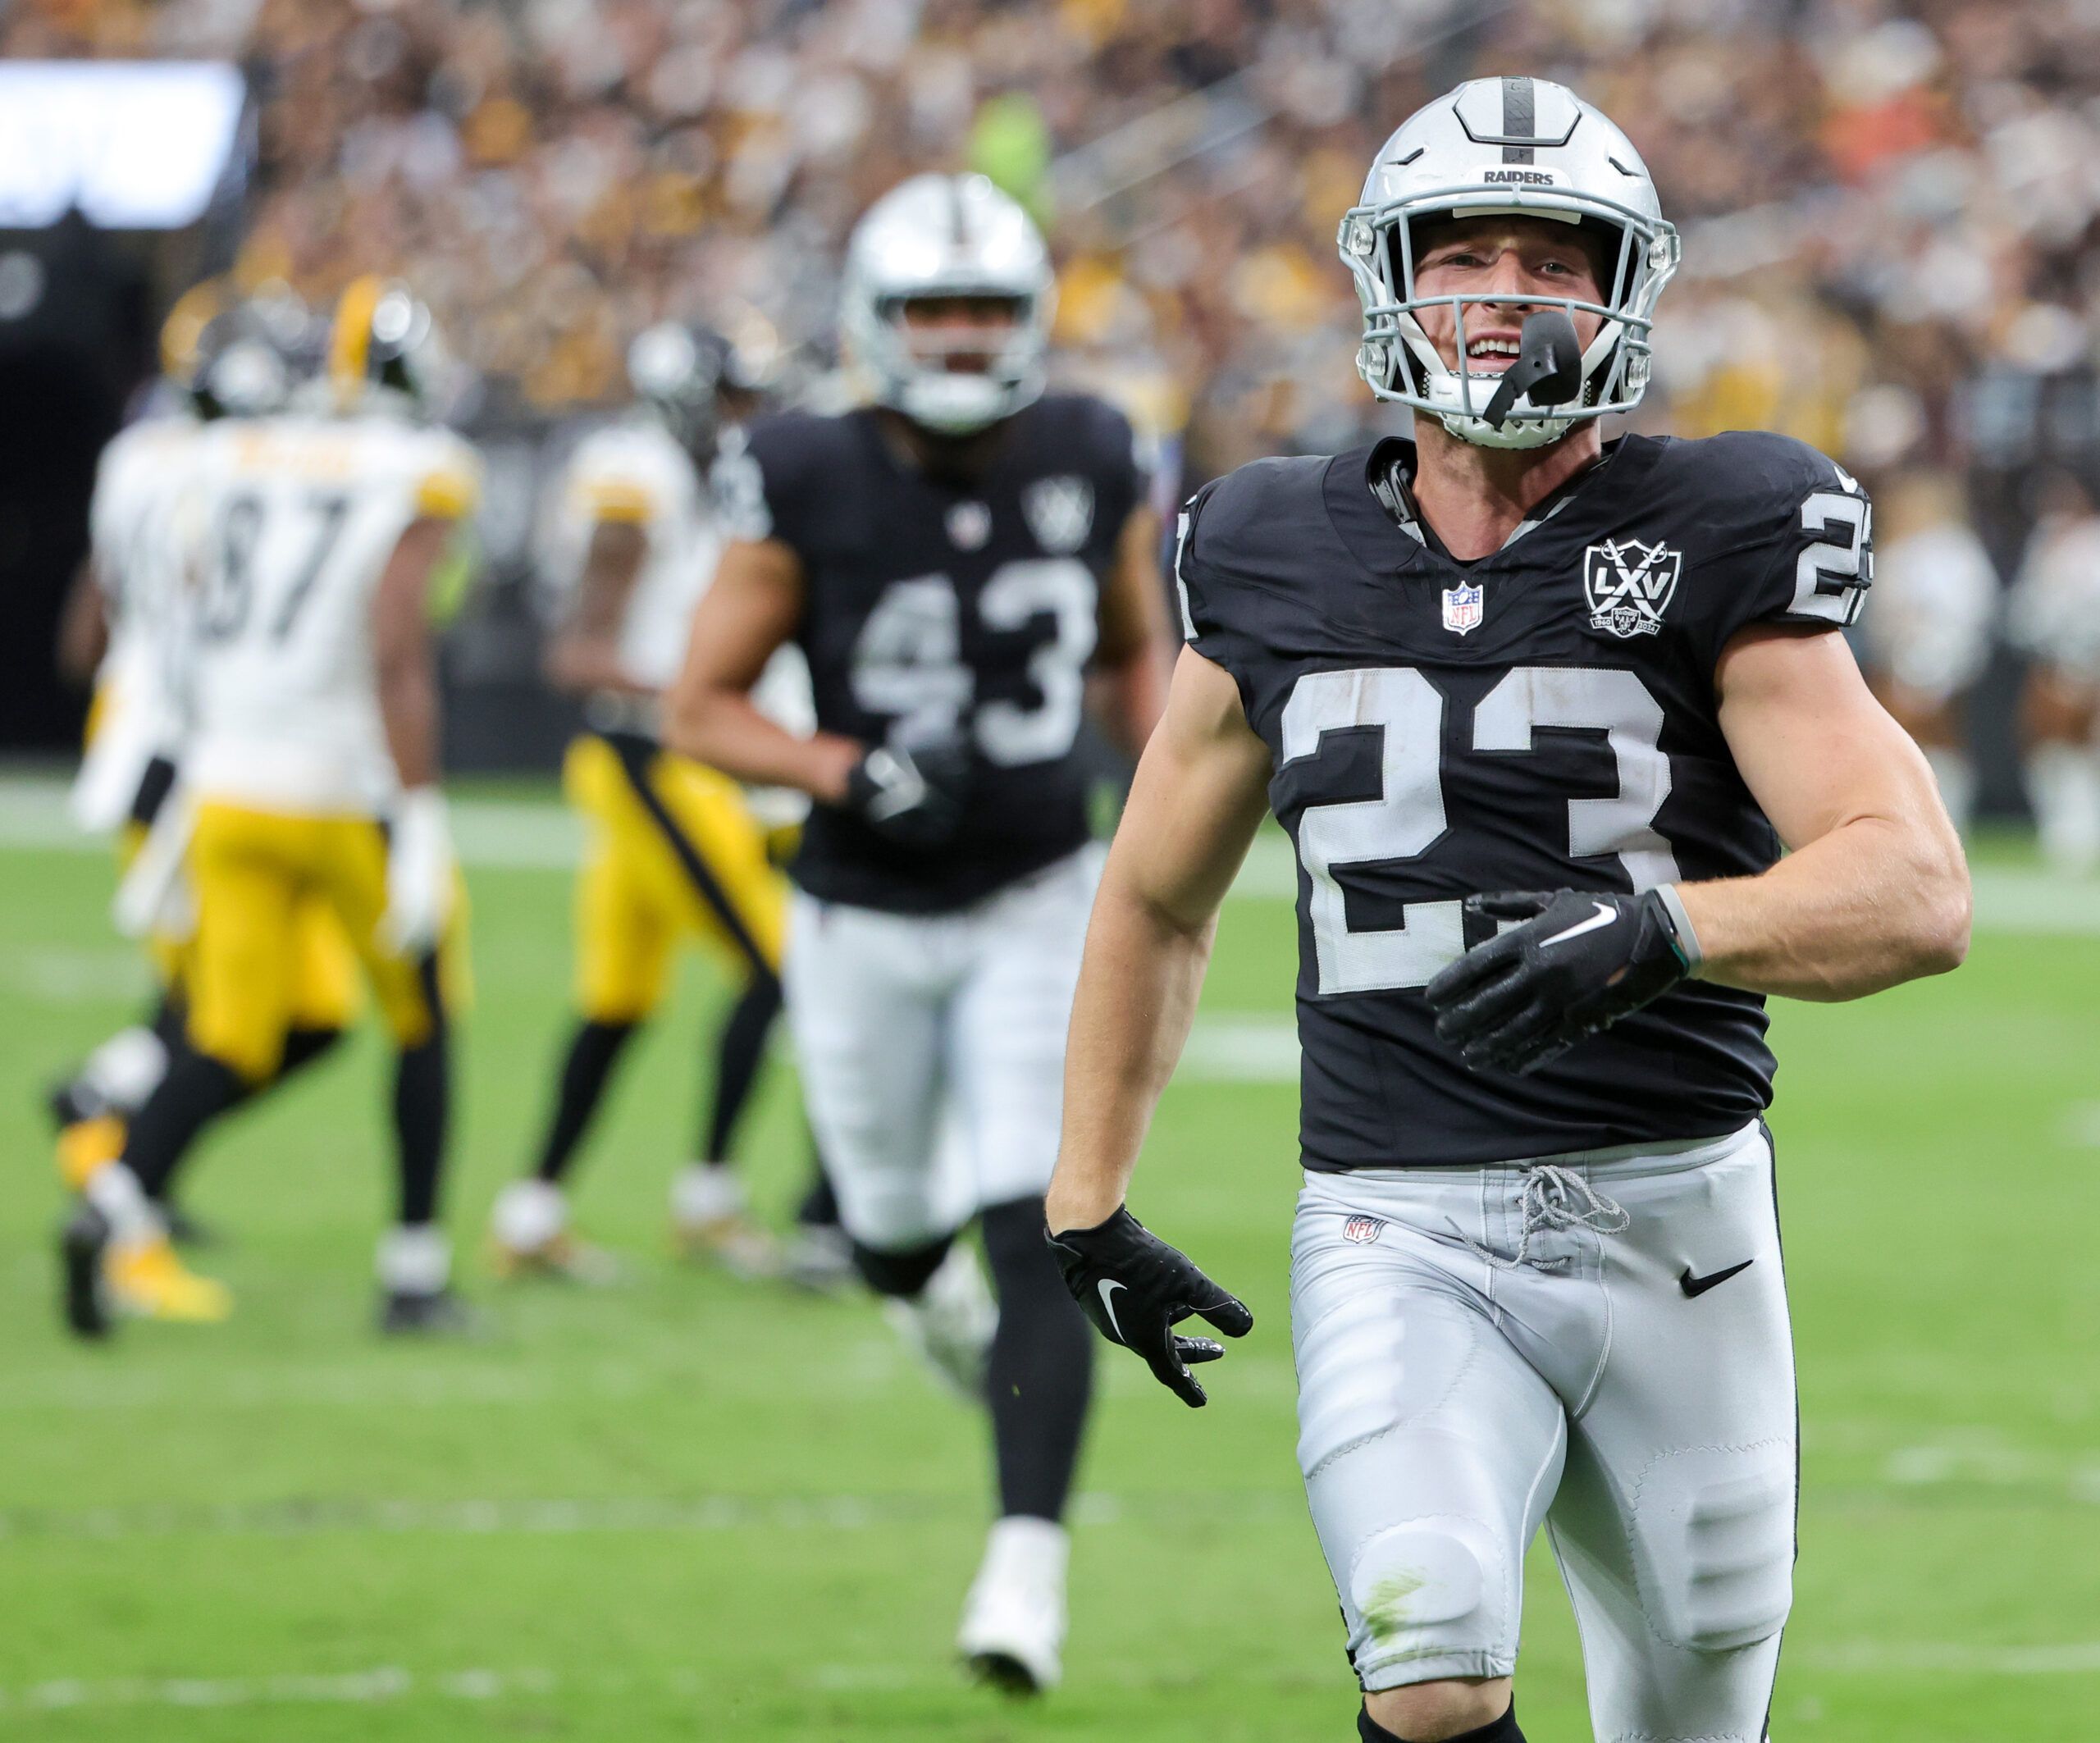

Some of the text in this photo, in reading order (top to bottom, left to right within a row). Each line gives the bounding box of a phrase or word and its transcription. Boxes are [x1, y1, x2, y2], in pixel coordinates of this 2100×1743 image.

[1484, 170, 1554, 185] RAIDERS
[1785, 493, 1874, 625] 2
[1594, 567, 1672, 600] LXV
[1450, 605, 1477, 625] NFL
[1638, 622, 1655, 632] 2024
[850, 558, 1098, 767] 43
[1281, 666, 1682, 995] 23
[1346, 1222, 1372, 1239] NFL
